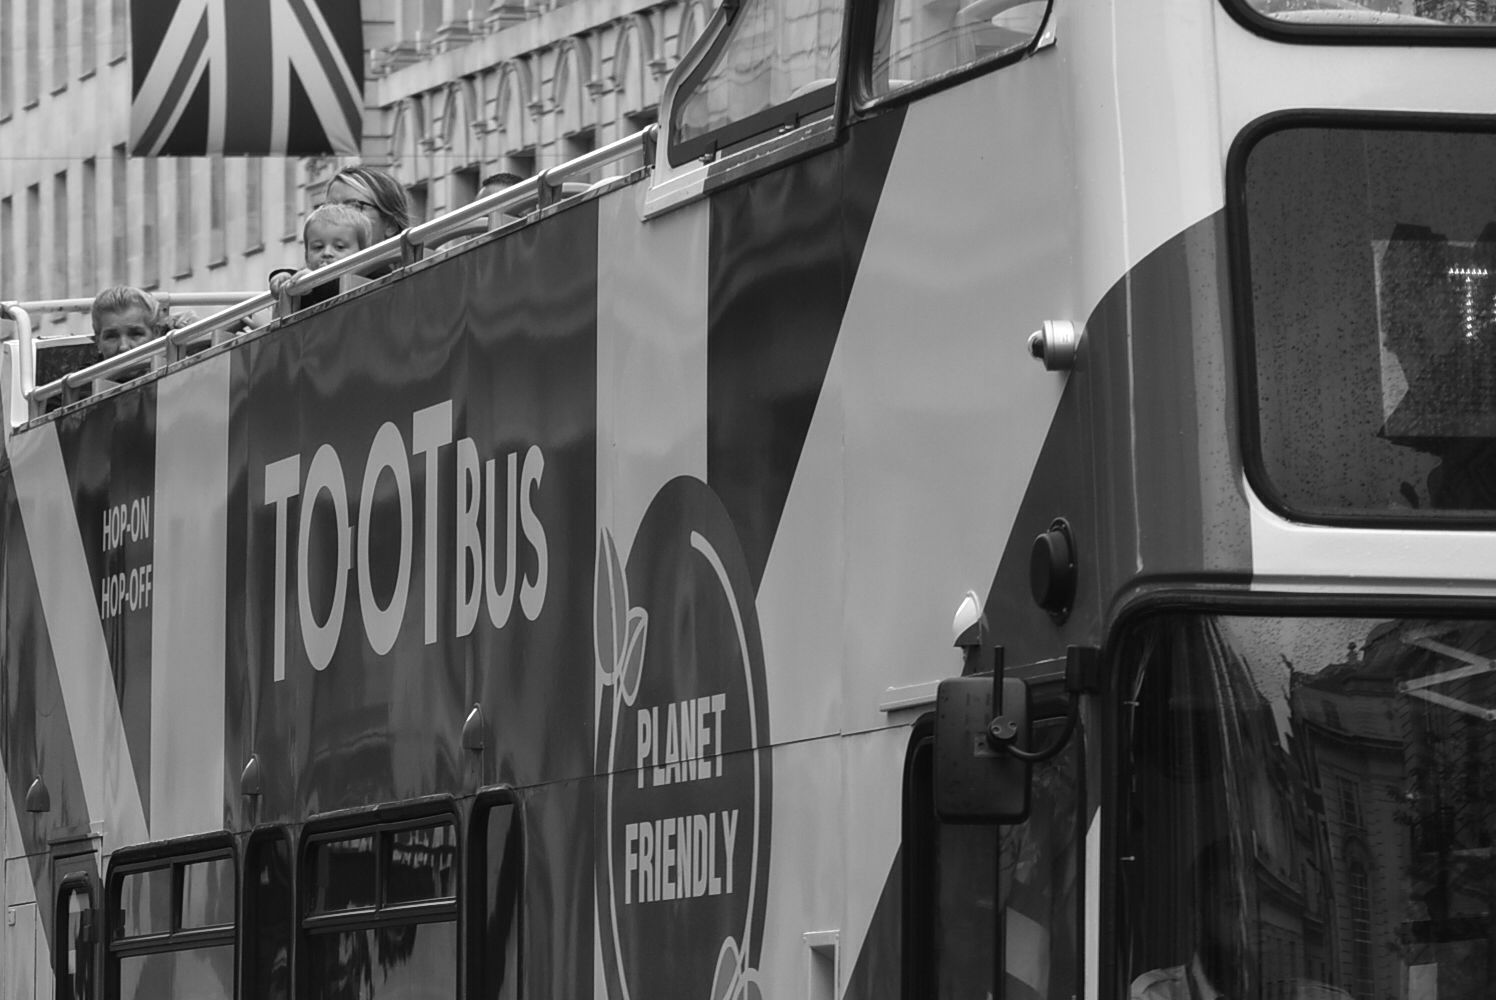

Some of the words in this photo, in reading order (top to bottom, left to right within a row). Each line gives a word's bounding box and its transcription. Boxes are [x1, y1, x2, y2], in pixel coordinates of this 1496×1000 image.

[102, 496, 150, 552] HOP-ON
[101, 564, 152, 619] HOP-OFF
[637, 693, 726, 789] PLANET
[625, 809, 739, 905] FRIENDLY
